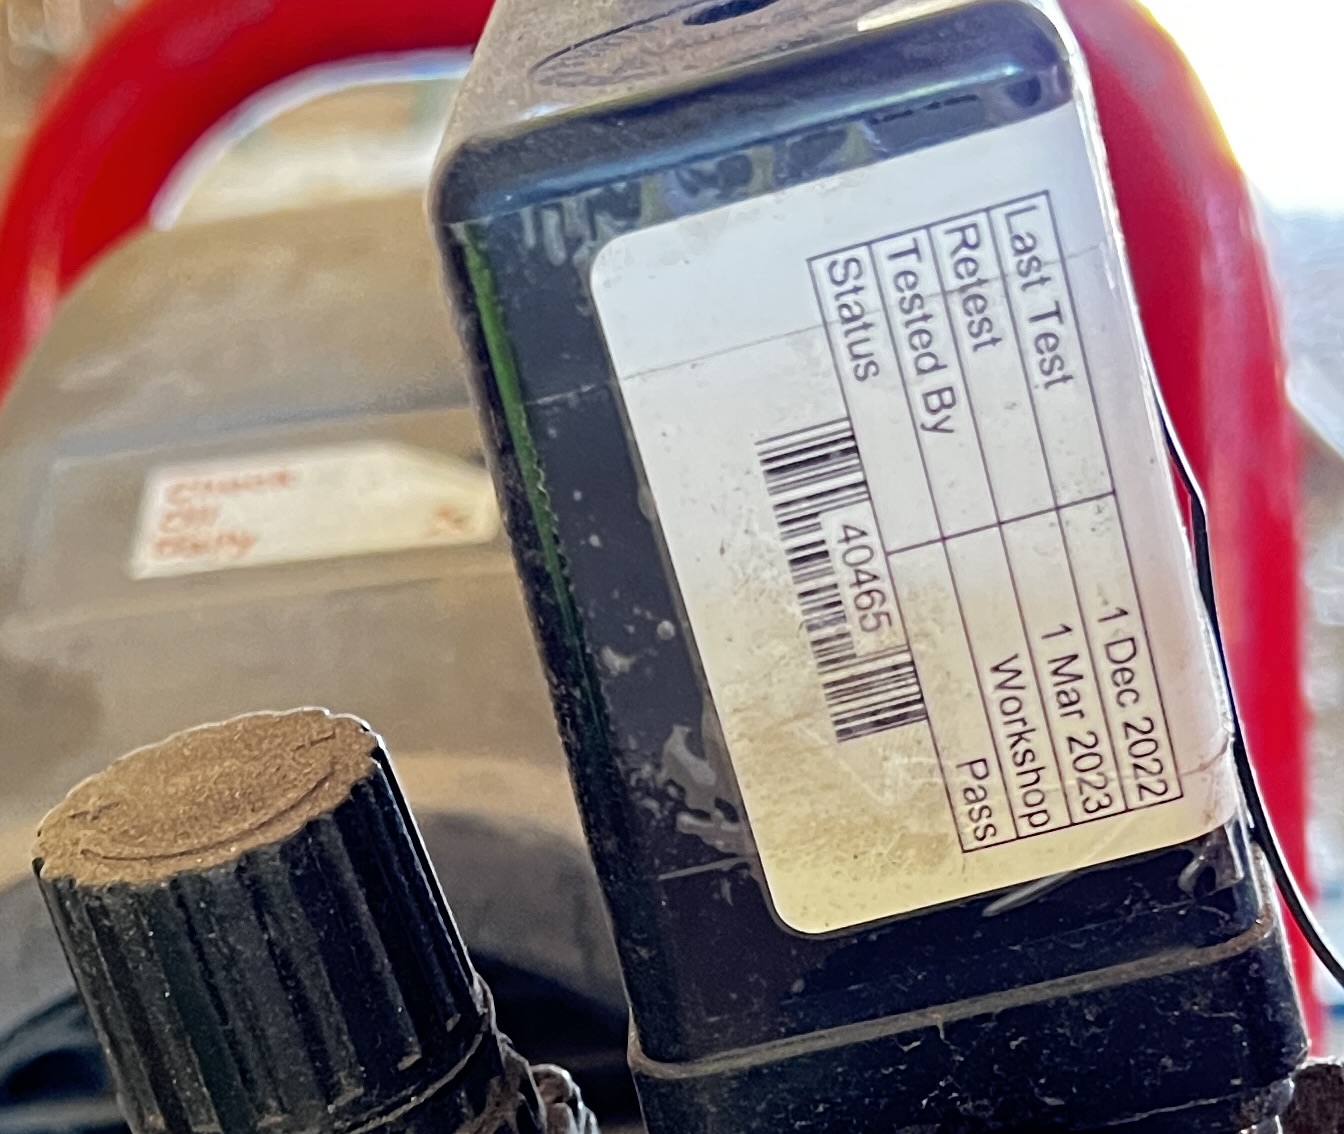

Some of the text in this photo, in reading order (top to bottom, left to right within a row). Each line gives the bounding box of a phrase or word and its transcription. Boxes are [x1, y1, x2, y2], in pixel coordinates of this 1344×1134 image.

[827, 258, 881, 384] Status
[886, 238, 957, 435] Tested By
[942, 222, 1004, 354] Retest
[1004, 205, 1075, 391] Last Test
[838, 523, 892, 634] 40465
[990, 653, 1052, 832] Workshop
[1042, 622, 1114, 815] 1 Mar 2023
[1095, 606, 1170, 803] 1 Dec 2022
[957, 757, 998, 843] Pass
